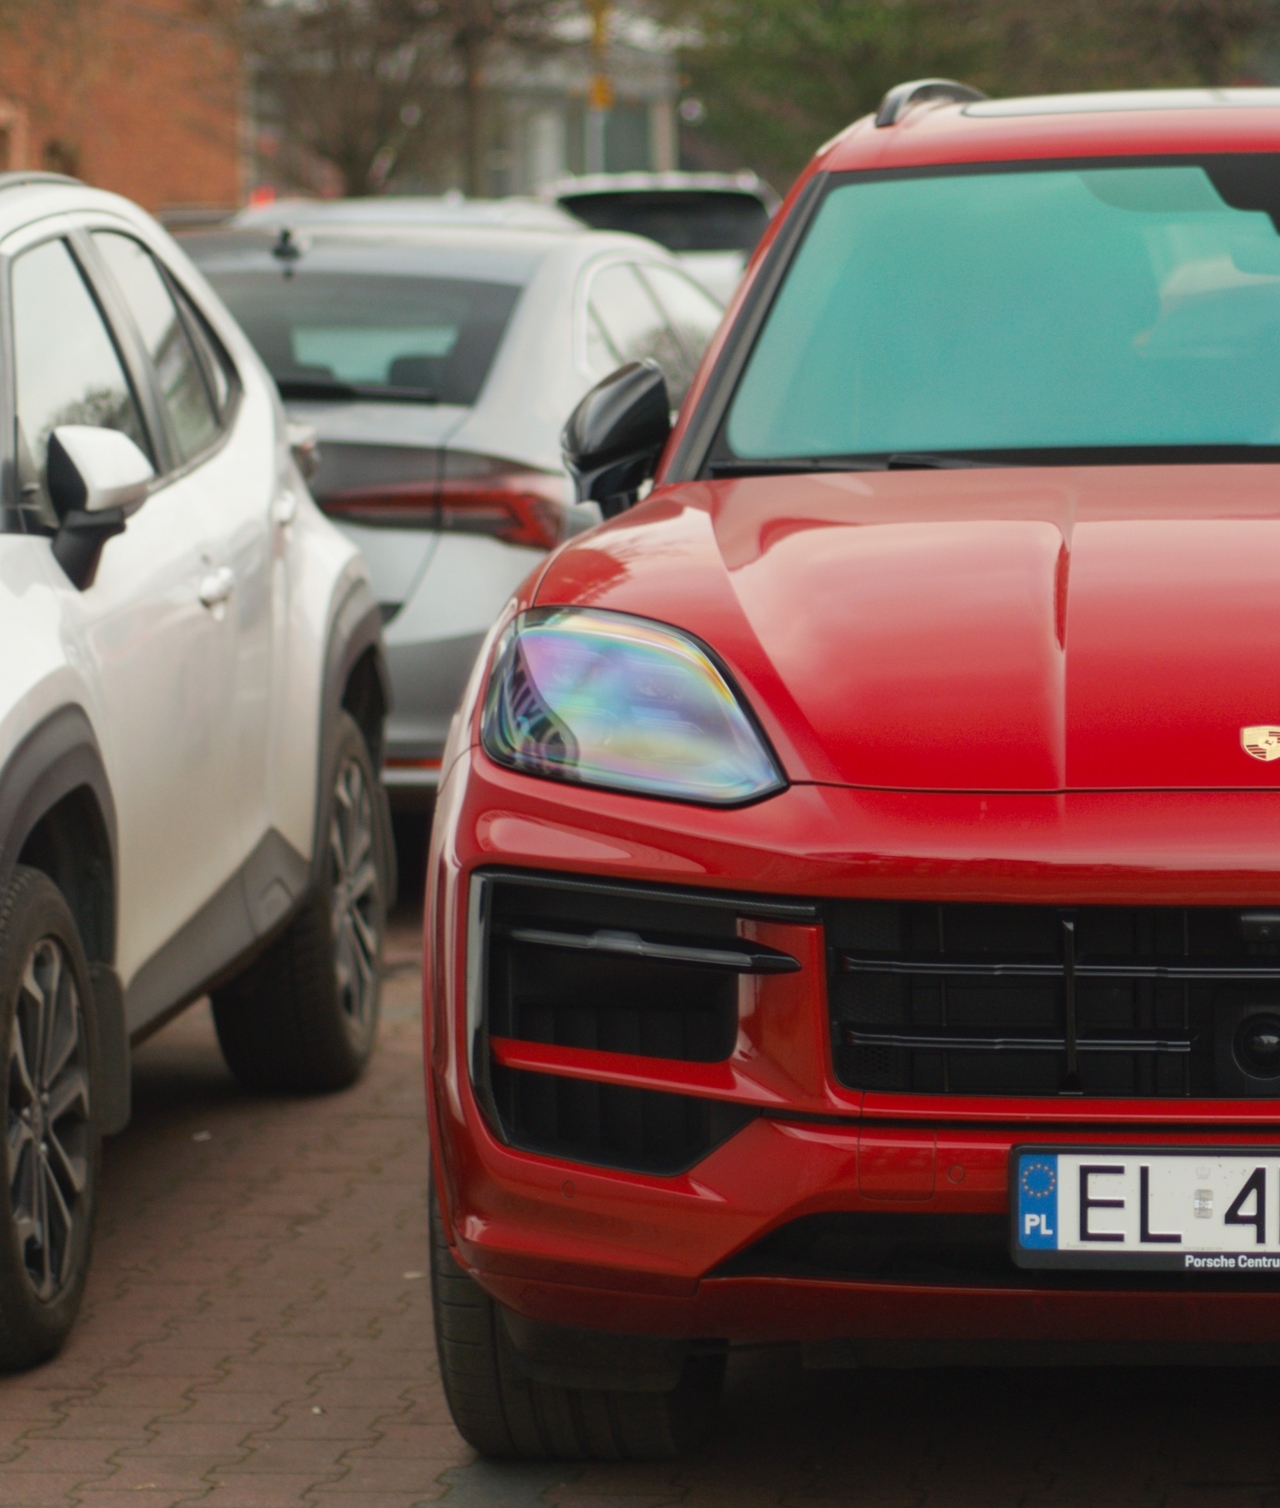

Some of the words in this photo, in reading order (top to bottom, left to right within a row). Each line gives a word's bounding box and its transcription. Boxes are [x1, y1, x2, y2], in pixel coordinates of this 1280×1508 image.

[1079, 1165, 1182, 1243] EL
[1024, 1214, 1053, 1236] PL
[1185, 1254, 1236, 1268] Porsche
